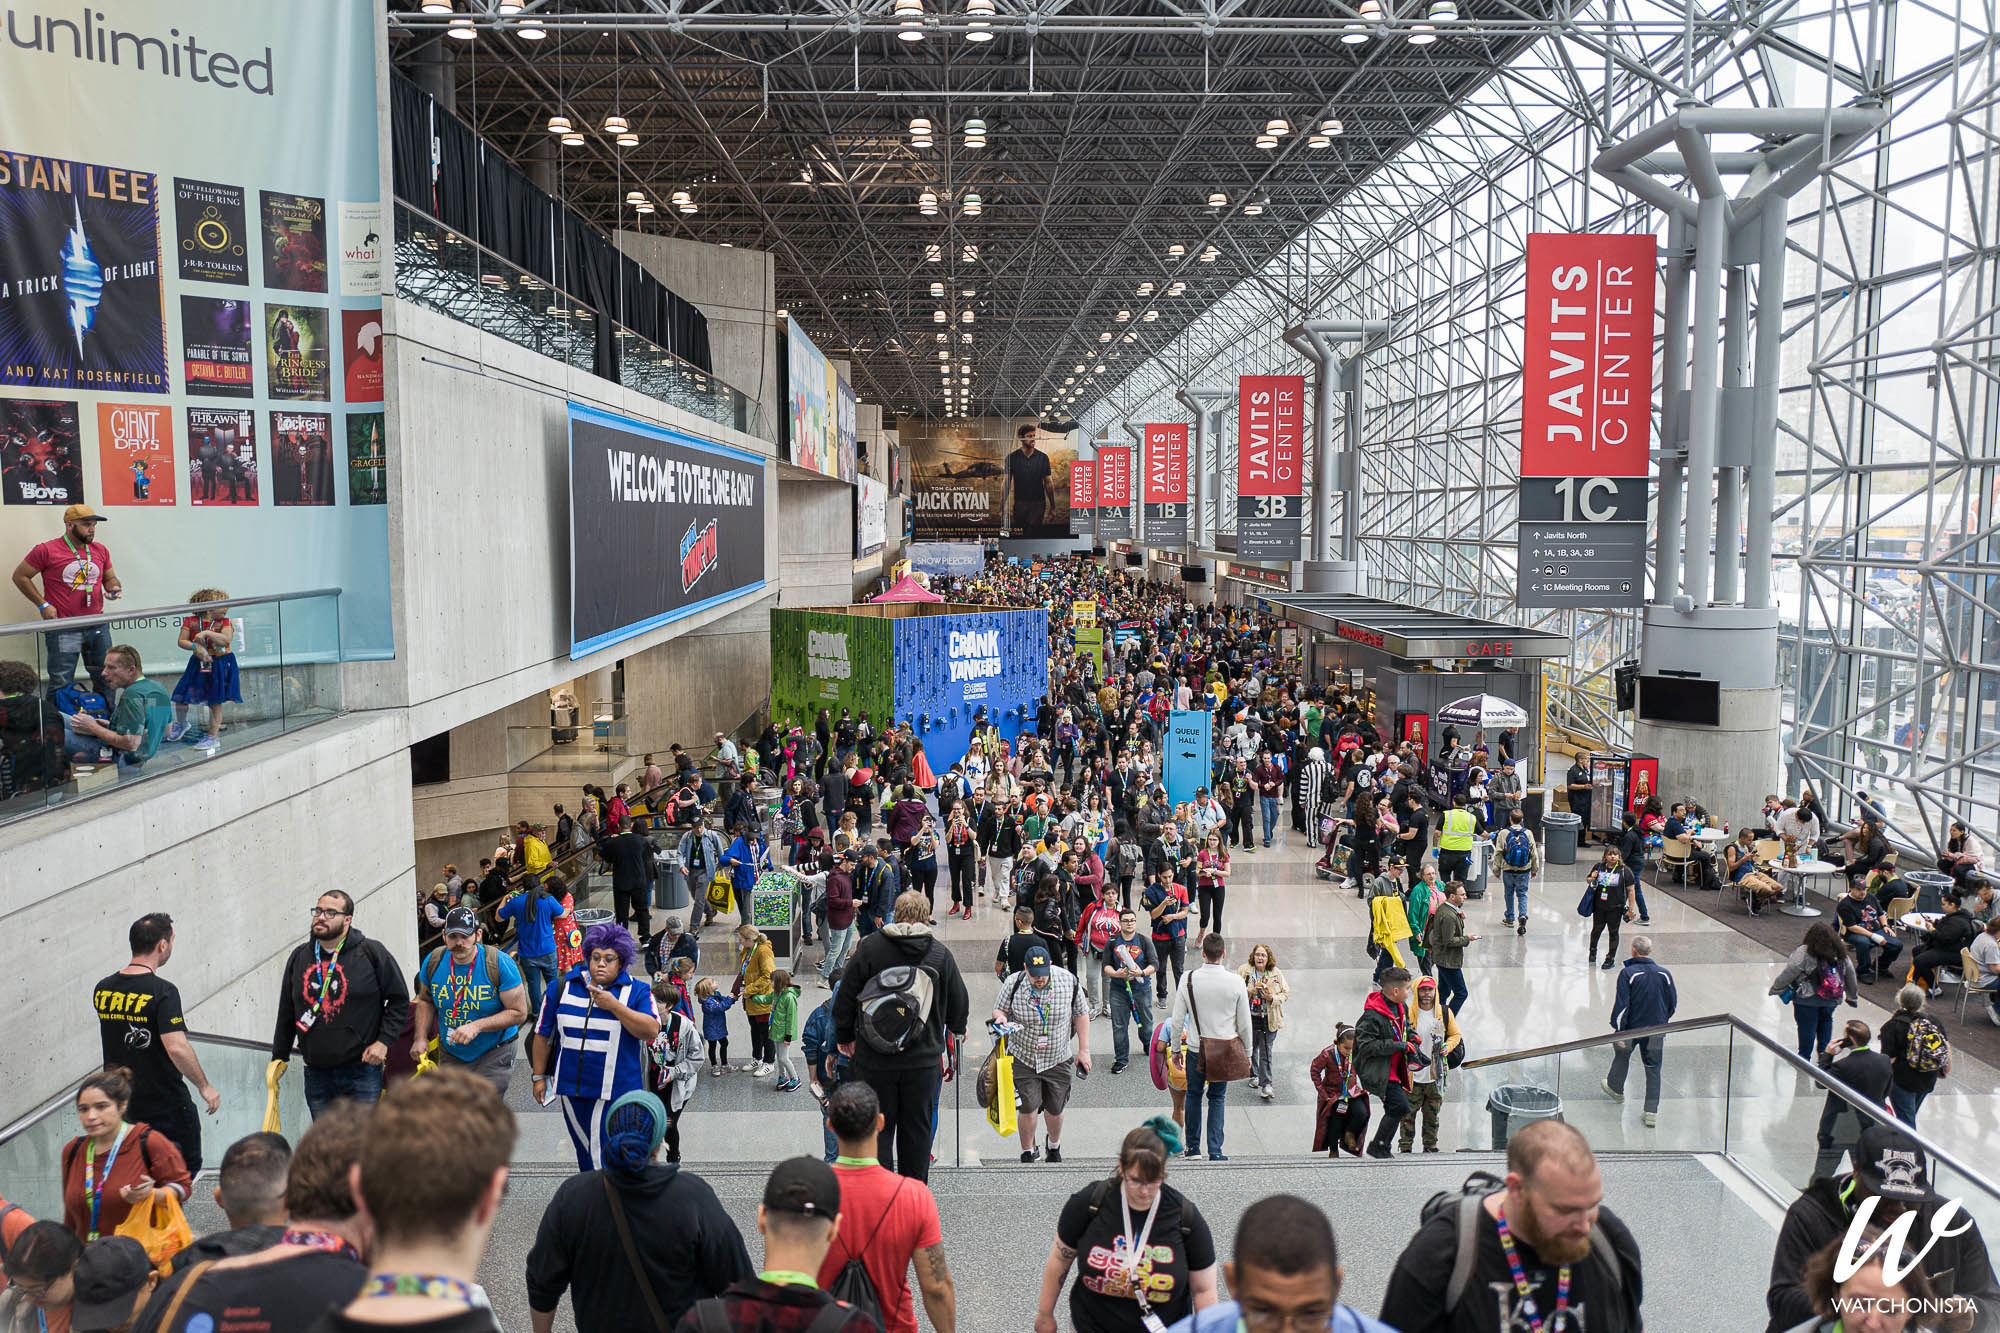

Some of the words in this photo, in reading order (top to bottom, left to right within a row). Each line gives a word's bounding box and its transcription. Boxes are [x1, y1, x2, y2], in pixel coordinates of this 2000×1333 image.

[7, 7, 274, 96] unlimited
[0, 153, 72, 194] STAN
[86, 165, 150, 205] LEE
[179, 190, 193, 199] OF
[193, 192, 215, 203] THE
[217, 194, 240, 206] RING
[181, 183, 196, 191] THE
[196, 184, 239, 197] FELLOWSHIP
[345, 245, 375, 260] what
[206, 261, 243, 272] TOLKIEN
[2, 285, 10, 298] A
[16, 275, 59, 296] TRICK
[105, 266, 119, 282] OF
[122, 259, 156, 280] LIGHT
[186, 347, 210, 360] PARABLE
[211, 349, 219, 360] OF
[220, 350, 230, 361] THE
[1547, 265, 1589, 442] JAVITS
[1600, 265, 1633, 446] CENTER
[224, 365, 247, 380] BUTLER
[274, 358, 326, 369] PRINCESS
[282, 367, 318, 377] BRIDE
[6, 364, 34, 379] AND
[43, 366, 68, 380] KAT
[77, 368, 162, 386] ROSENFIELD
[110, 409, 161, 440] GIANT
[191, 414, 239, 425] THRAWN
[114, 438, 160, 451] DAYS
[1250, 391, 1270, 480] JAVITS
[1277, 390, 1294, 481] CENTER
[1152, 433, 1166, 493] JAVITS
[1170, 432, 1181, 493] CENTER
[607, 448, 676, 504] WELCOME
[676, 461, 693, 505] TO
[692, 464, 712, 506] THE
[712, 467, 730, 507] ONE
[731, 472, 738, 506] &
[737, 473, 755, 507] ONLY
[1074, 465, 1083, 503] JAVITS
[1085, 465, 1093, 503] CENTER
[1104, 454, 1114, 499] JAVITS
[1117, 453, 1126, 499] CENTER
[18, 481, 37, 490] THE
[22, 487, 69, 500] BOYS
[915, 491, 951, 510] JACK
[953, 491, 990, 510] RYAN
[1254, 495, 1287, 519] 3B
[1554, 477, 1619, 522] 1C
[1076, 508, 1090, 518] 1A
[1105, 506, 1123, 518] 3A
[1156, 502, 1177, 518] 1B
[1543, 532, 1565, 540] Javits
[1566, 532, 1588, 540] North
[1543, 550, 1555, 558] 1A,
[1558, 550, 1569, 558] 1B,
[1570, 550, 1582, 558] 3A,
[1554, 583, 1583, 593] Meeting
[949, 629, 1000, 659] CRANK
[1466, 641, 1513, 656] CAFÉ
[948, 656, 1002, 683] YANKERS
[1175, 727, 1200, 736] QUEUE
[1033, 956, 1044, 966] M
[431, 984, 492, 1001] TAYNE
[94, 990, 154, 1014] STAFF
